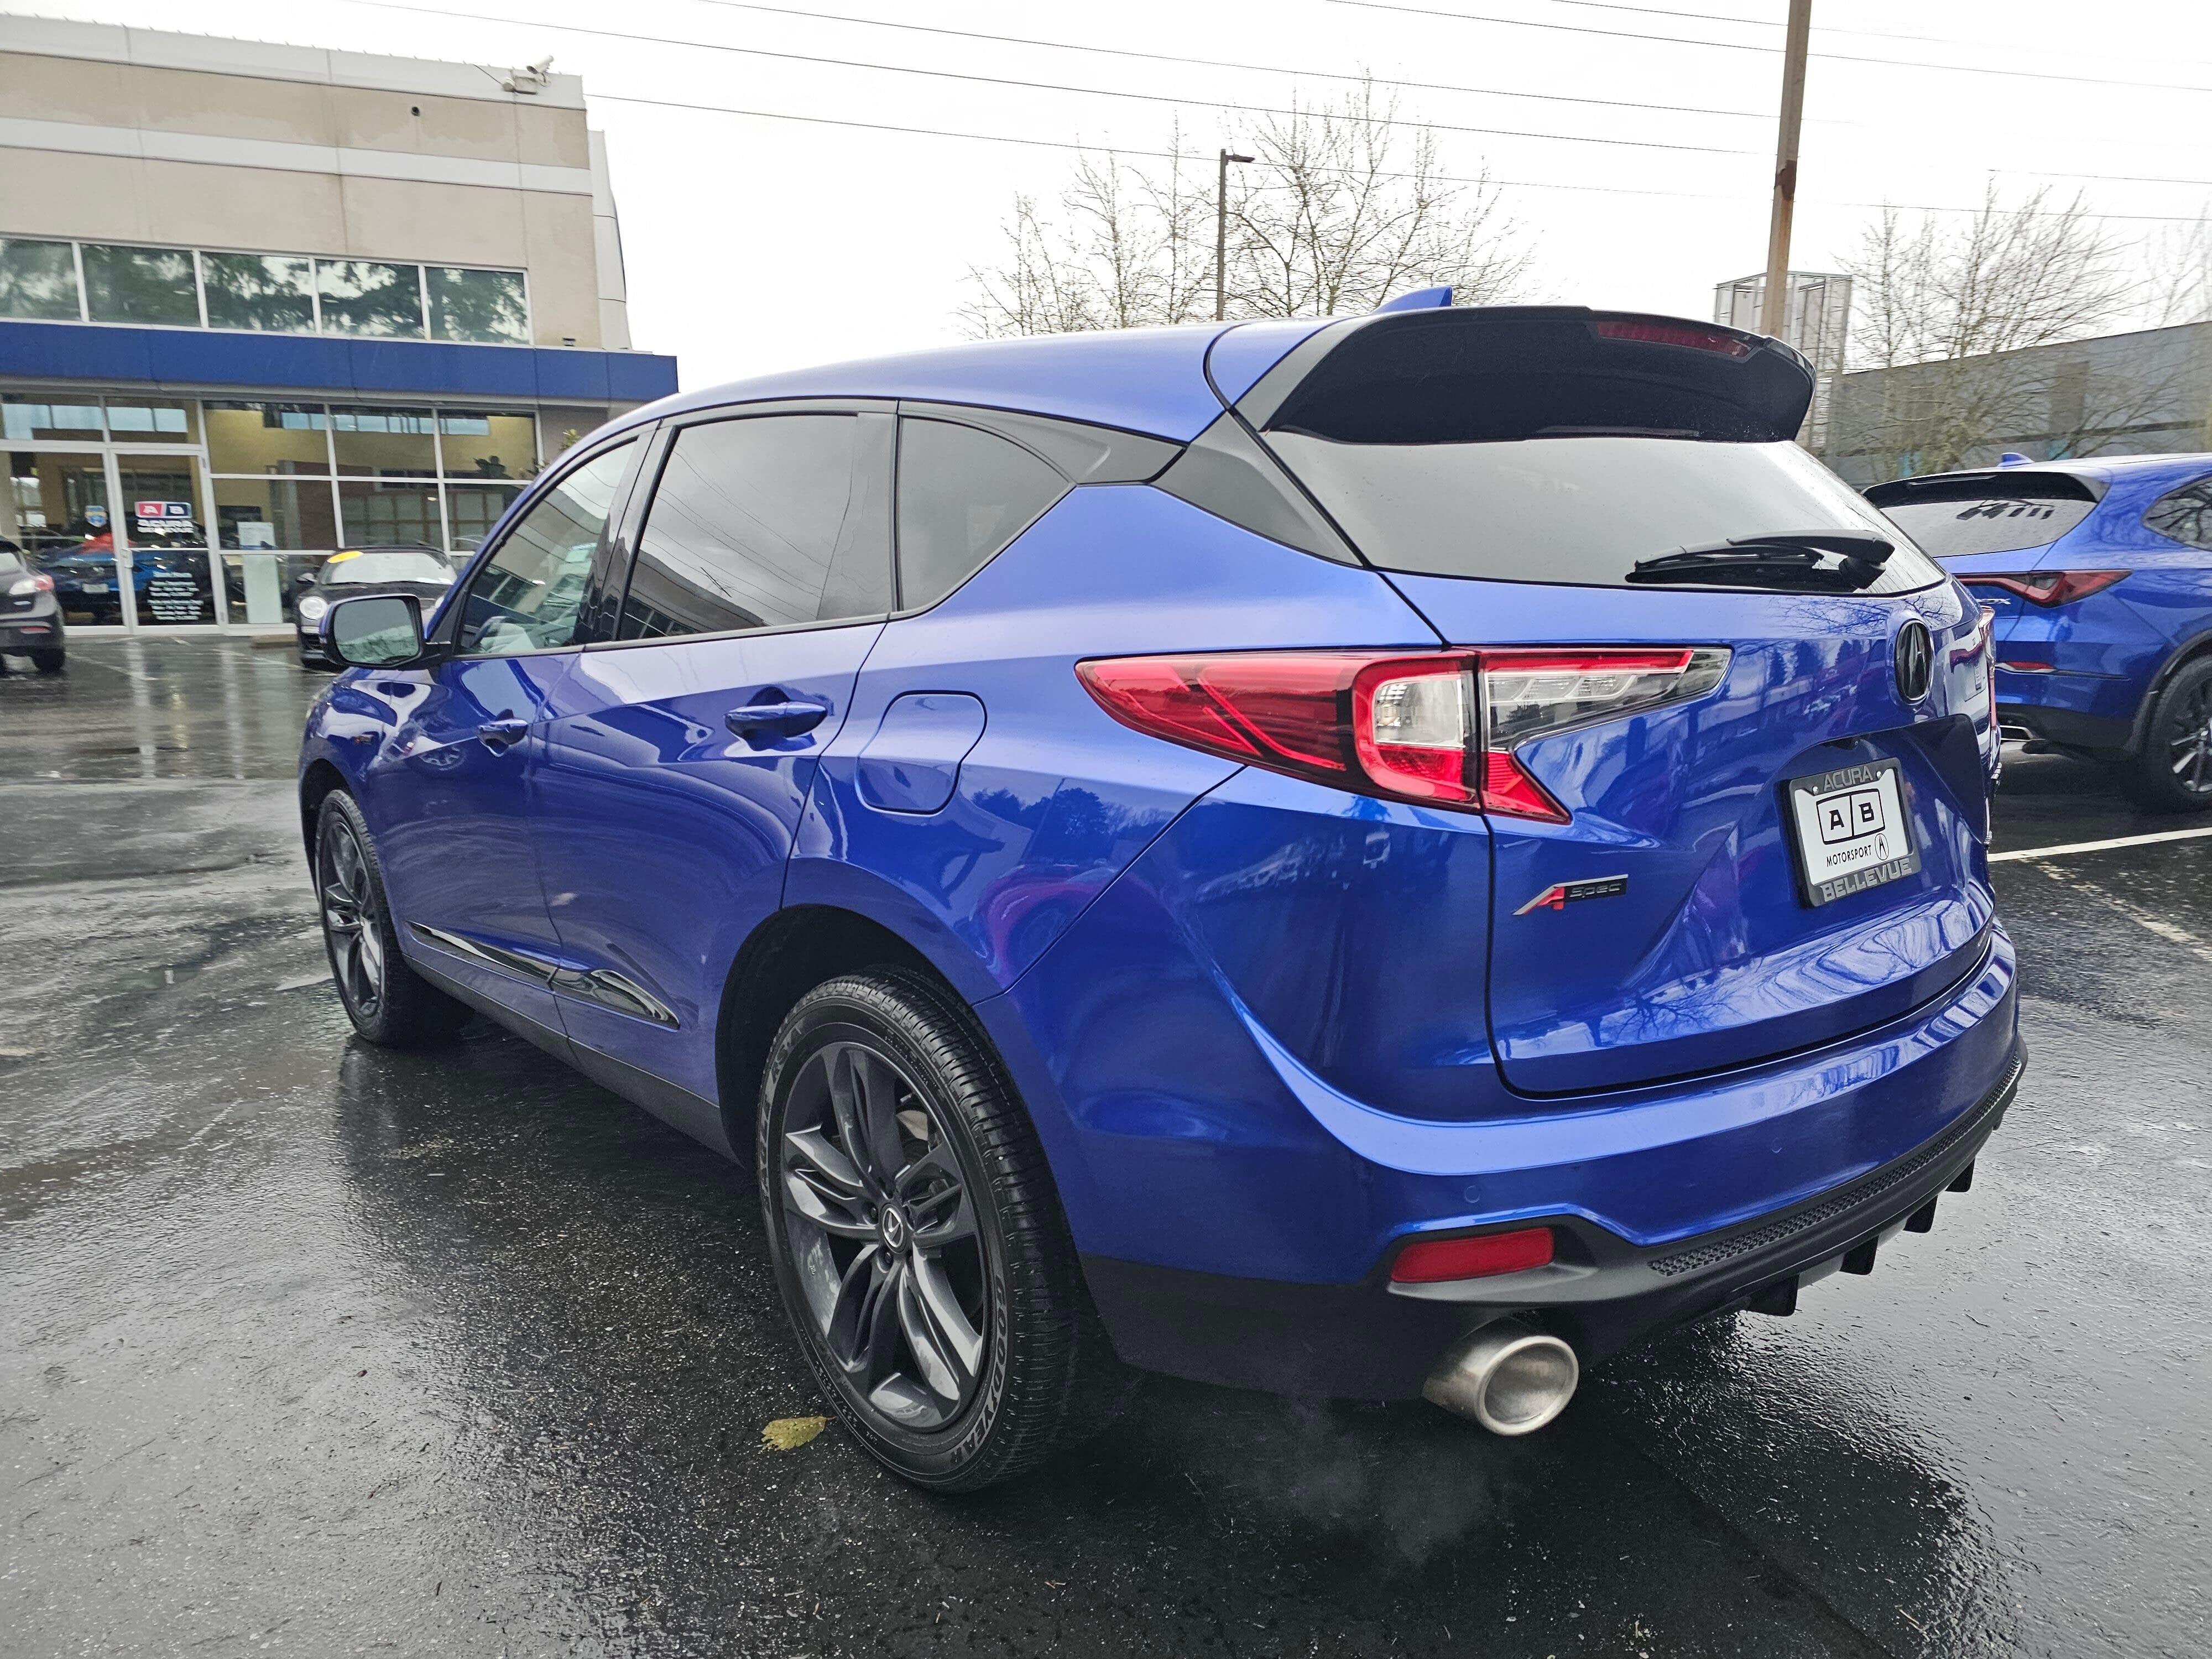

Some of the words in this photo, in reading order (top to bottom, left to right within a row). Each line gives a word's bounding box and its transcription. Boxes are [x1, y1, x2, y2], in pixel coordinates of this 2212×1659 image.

[1824, 765, 1874, 791] ACURA
[1829, 809, 1845, 831] A
[1858, 802, 1875, 823] B
[1826, 847, 1872, 868] MOTORSPORT
[1820, 858, 1912, 902] BELLEVUE
[950, 1272, 1007, 1465] GOODYEAR
